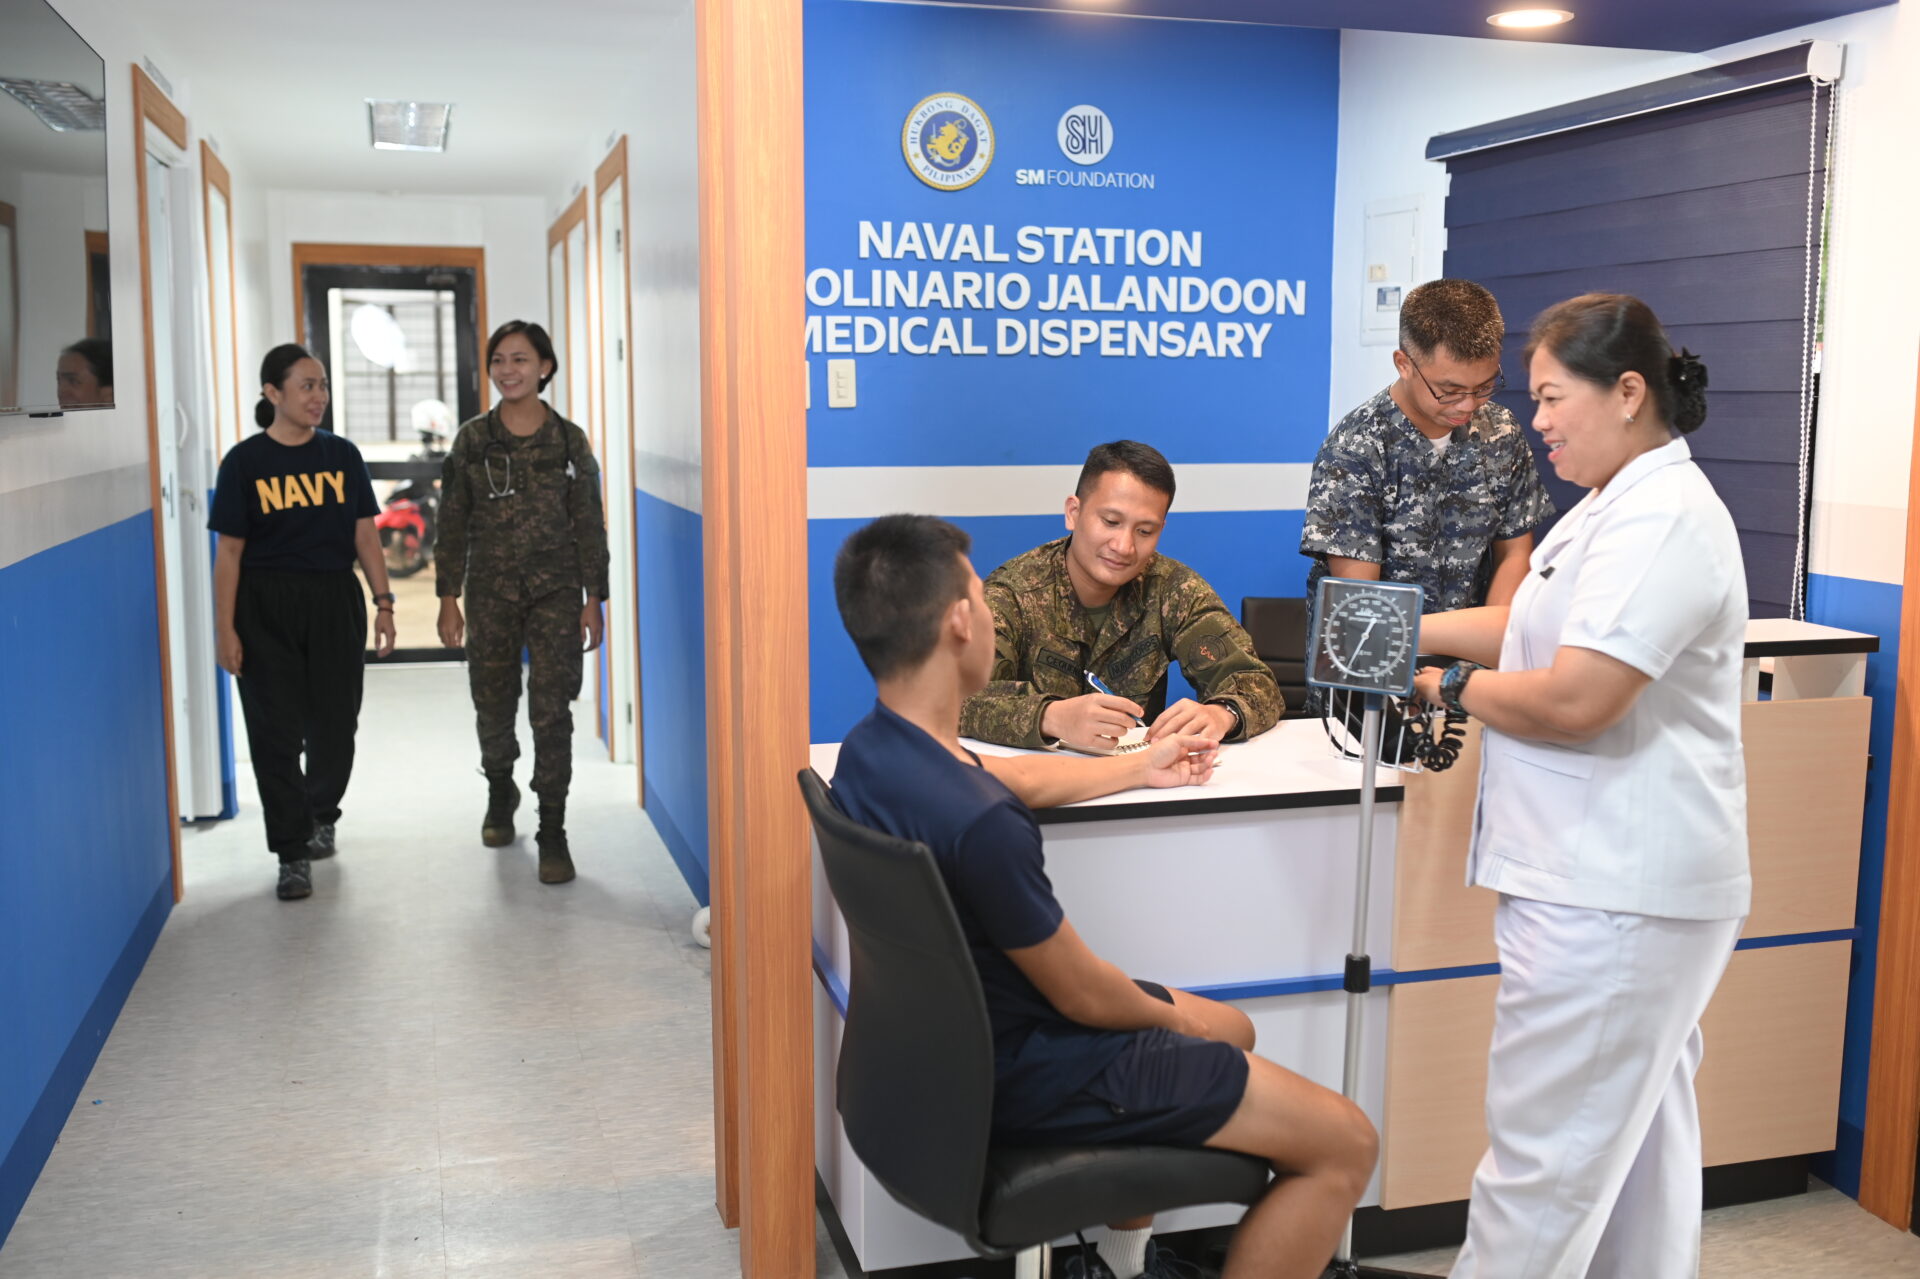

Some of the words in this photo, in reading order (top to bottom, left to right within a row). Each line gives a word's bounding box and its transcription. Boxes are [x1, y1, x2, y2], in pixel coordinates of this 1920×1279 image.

[910, 101, 953, 144] HUKBONG
[961, 105, 987, 142] DAGAT
[922, 164, 976, 183] PILIPINAS
[858, 220, 1009, 262] NAVAL
[1016, 226, 1201, 267] STATION
[1038, 274, 1306, 316] JALANDOON
[997, 318, 1273, 358] DISPENSARY
[255, 470, 345, 514] NAVY
